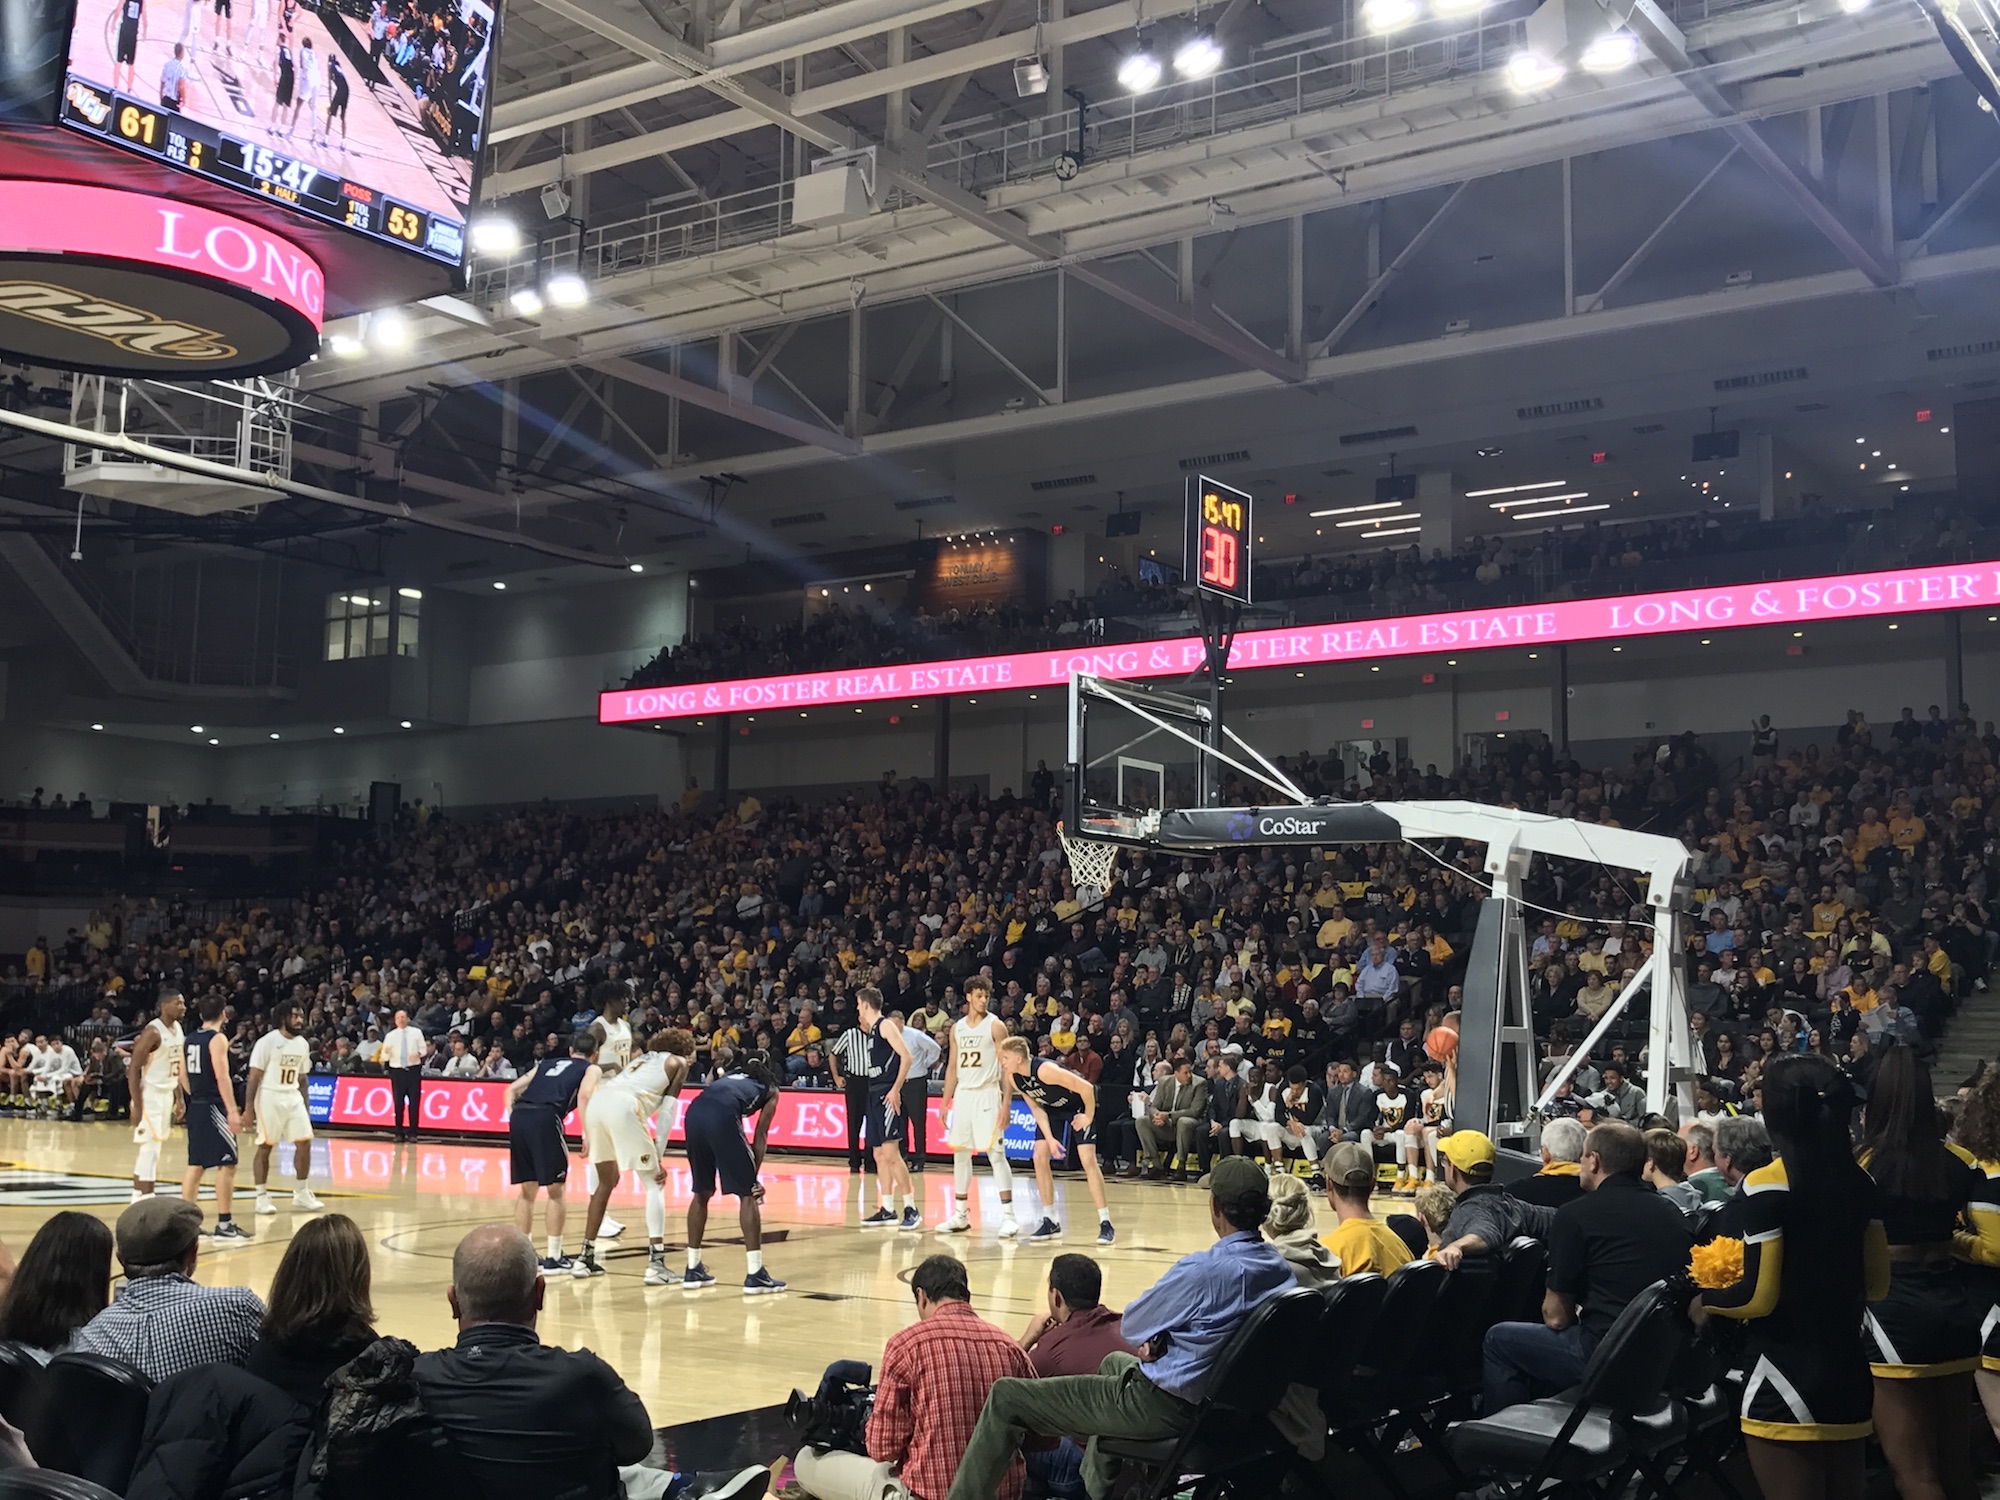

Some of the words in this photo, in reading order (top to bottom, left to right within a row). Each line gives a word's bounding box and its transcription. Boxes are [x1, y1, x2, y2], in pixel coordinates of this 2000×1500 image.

[66, 83, 112, 124] VCU
[120, 106, 155, 144] 61
[166, 145, 186, 162] FLS
[189, 156, 200, 169] 0
[168, 132, 187, 150] TOL
[191, 141, 202, 155] 3
[240, 143, 318, 193] 15:47
[261, 181, 271, 194] 2
[275, 186, 298, 202] HALF
[343, 182, 373, 203] POSS
[345, 212, 355, 226] 2
[353, 213, 370, 230] FLS
[354, 201, 370, 218] TOL
[387, 206, 419, 240] 53
[155, 209, 320, 314] LONG
[1204, 526, 1236, 587] 30
[1609, 594, 1736, 630] LONG
[1750, 588, 1785, 617] &
[1796, 573, 1976, 613] FOSTER
[624, 691, 696, 716] LONG
[702, 687, 725, 708] &
[729, 680, 828, 706] FOSTER
[836, 671, 908, 697] REAL
[910, 662, 1013, 689] ESTATE
[1048, 650, 1139, 679] LONG
[1148, 645, 1172, 670] &
[1181, 635, 1311, 667] FSTER
[1320, 622, 1409, 656] REAL
[1419, 611, 1558, 645] ESTATE
[960, 1036, 983, 1048] VCU
[187, 1044, 202, 1074] 21
[544, 1060, 574, 1077] 3
[960, 1051, 982, 1068] 22
[280, 1068, 297, 1085] 10
[343, 1085, 450, 1120] LOG
[461, 1087, 490, 1122] &
